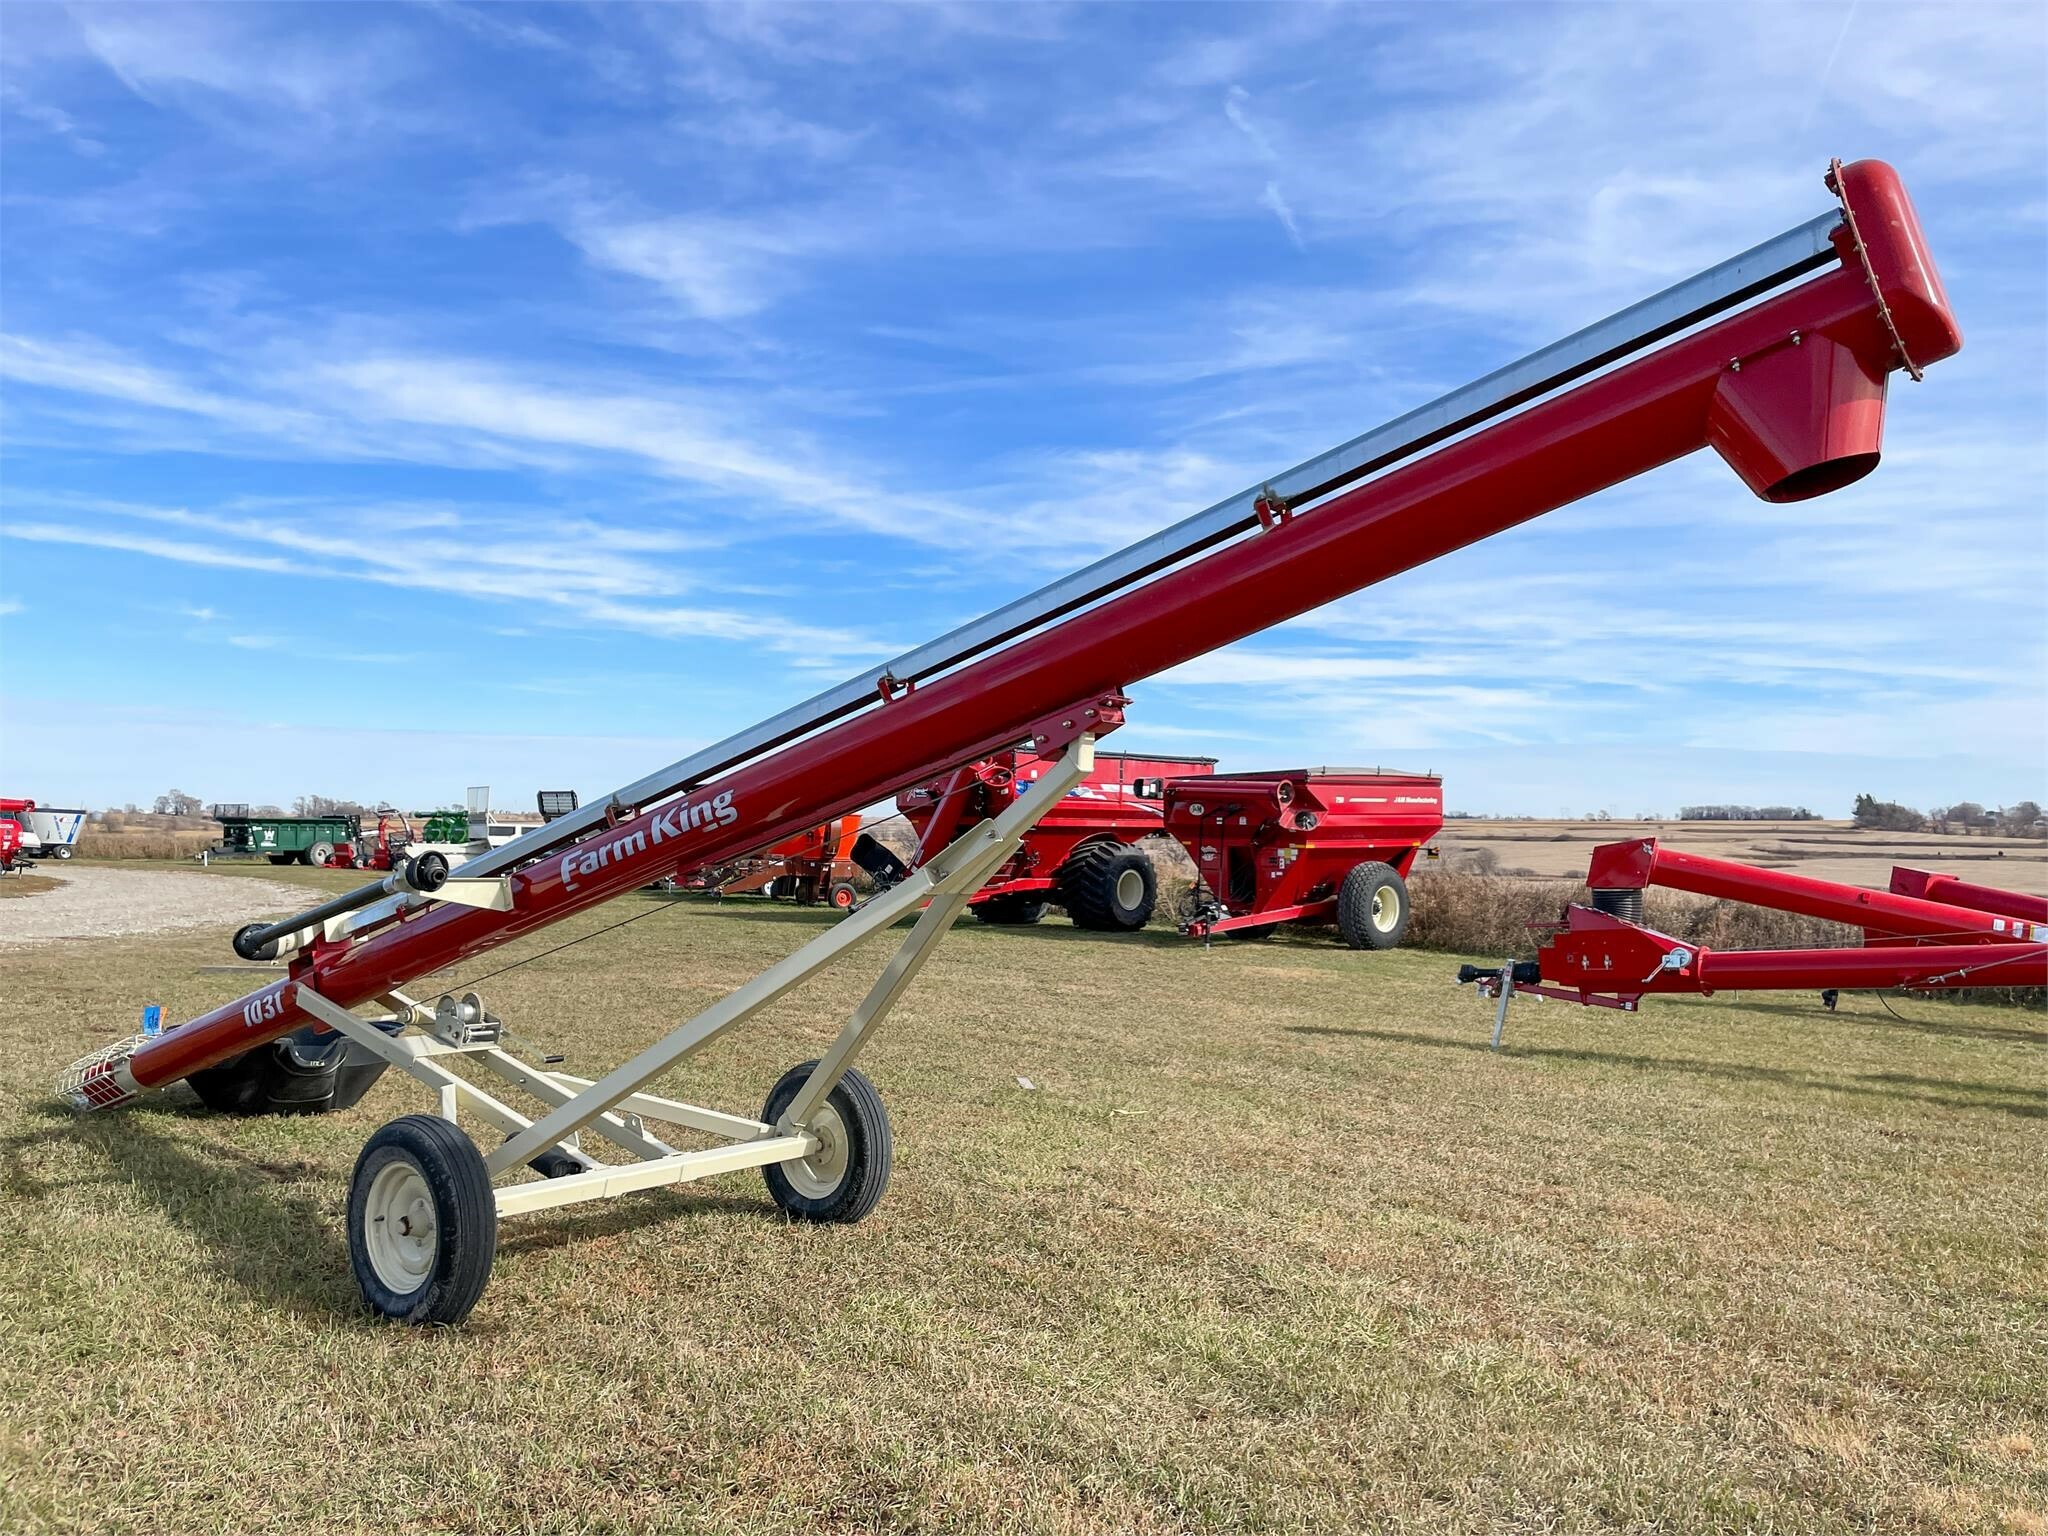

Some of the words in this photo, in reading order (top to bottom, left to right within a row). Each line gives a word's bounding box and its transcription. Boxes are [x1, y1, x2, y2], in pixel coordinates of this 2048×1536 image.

[560, 829, 647, 885] Farm
[651, 789, 739, 845] King
[243, 990, 285, 1028] 1031
